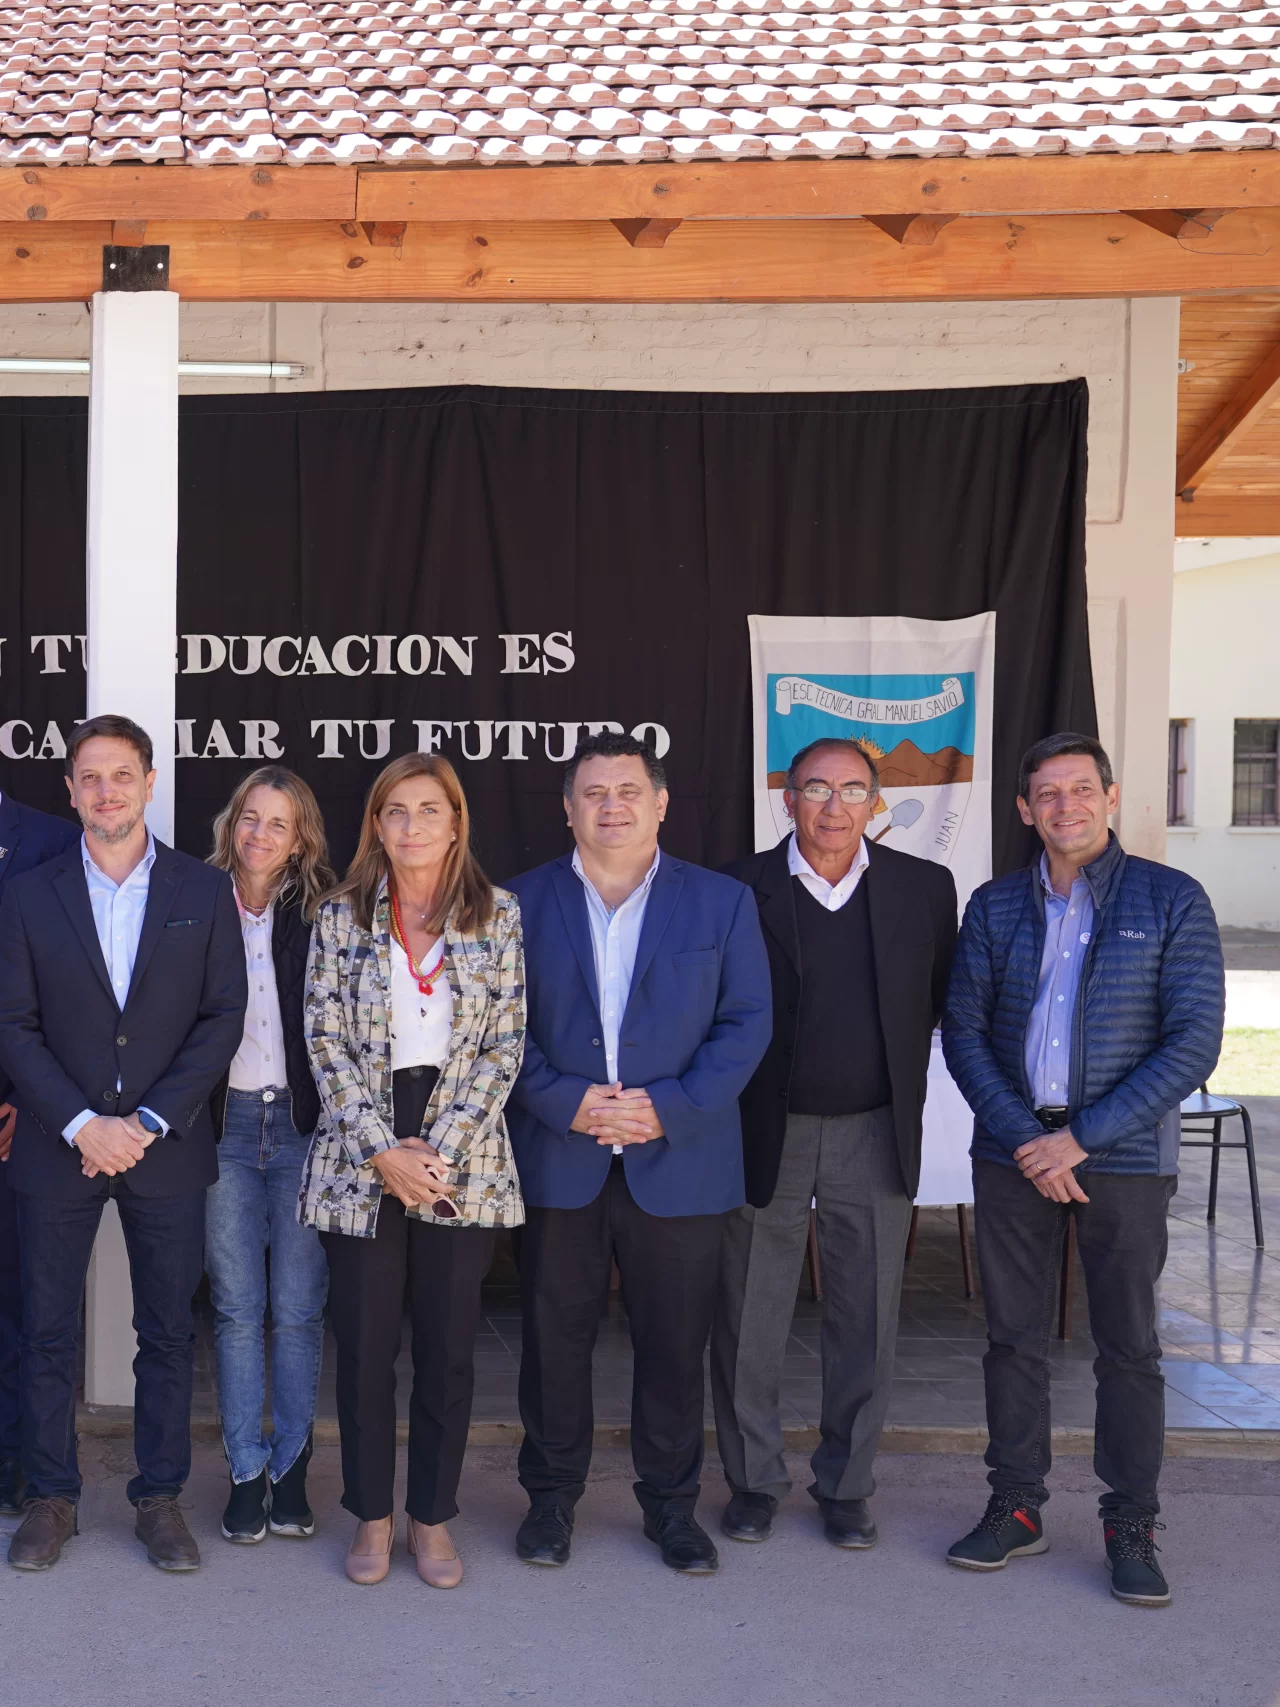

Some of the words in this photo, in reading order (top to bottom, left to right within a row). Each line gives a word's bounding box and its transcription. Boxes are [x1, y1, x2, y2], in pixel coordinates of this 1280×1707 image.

[175, 634, 479, 677] DUCACION
[497, 630, 576, 676] ES
[816, 687, 853, 717] TECNICA
[857, 701, 883, 721] GRAL
[884, 703, 925, 721] MANUEL
[926, 691, 959, 718] SAVIO
[310, 718, 396, 760] TU
[934, 810, 959, 852] JUAN
[1127, 929, 1146, 939] Rab
